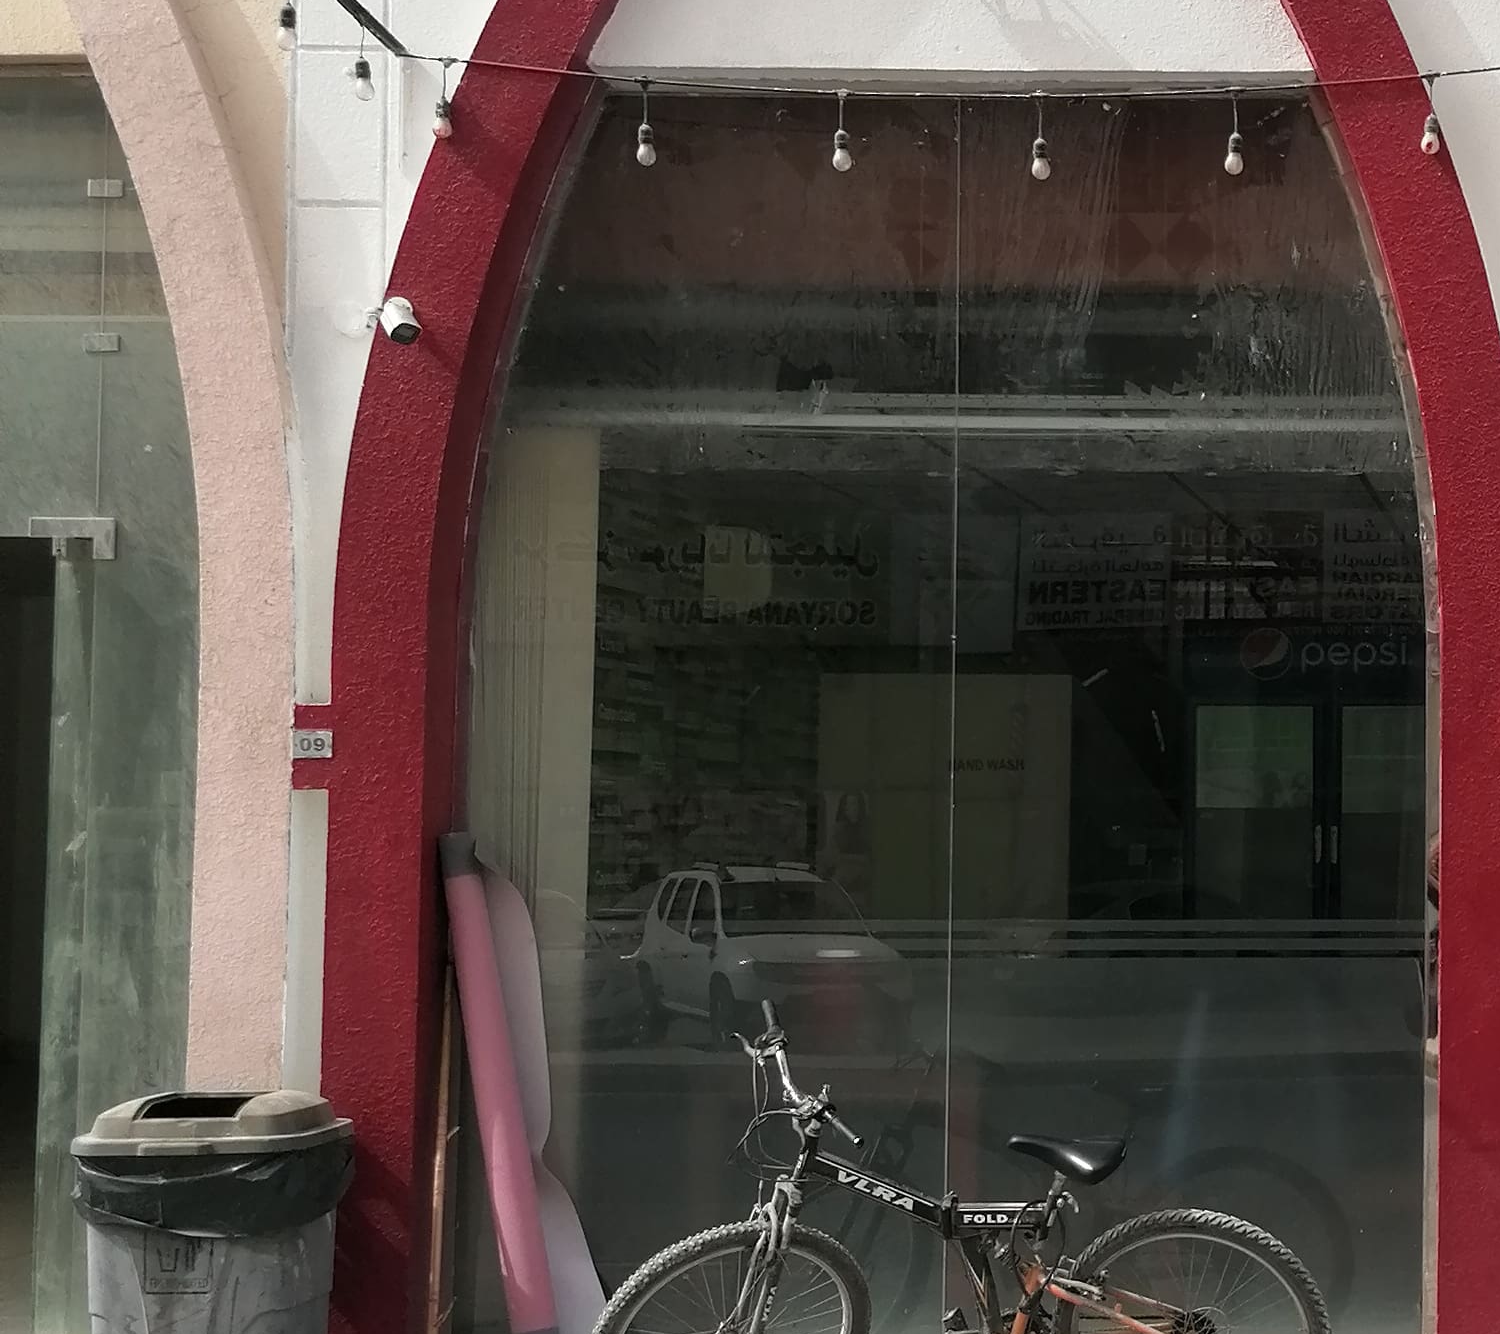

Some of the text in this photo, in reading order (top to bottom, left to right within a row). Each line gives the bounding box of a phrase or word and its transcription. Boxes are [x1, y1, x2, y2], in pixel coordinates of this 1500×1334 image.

[1301, 636, 1408, 674] pepsi
[300, 737, 326, 752] 09
[836, 1169, 915, 1212] VLRA
[963, 1213, 1009, 1224] FOLD
